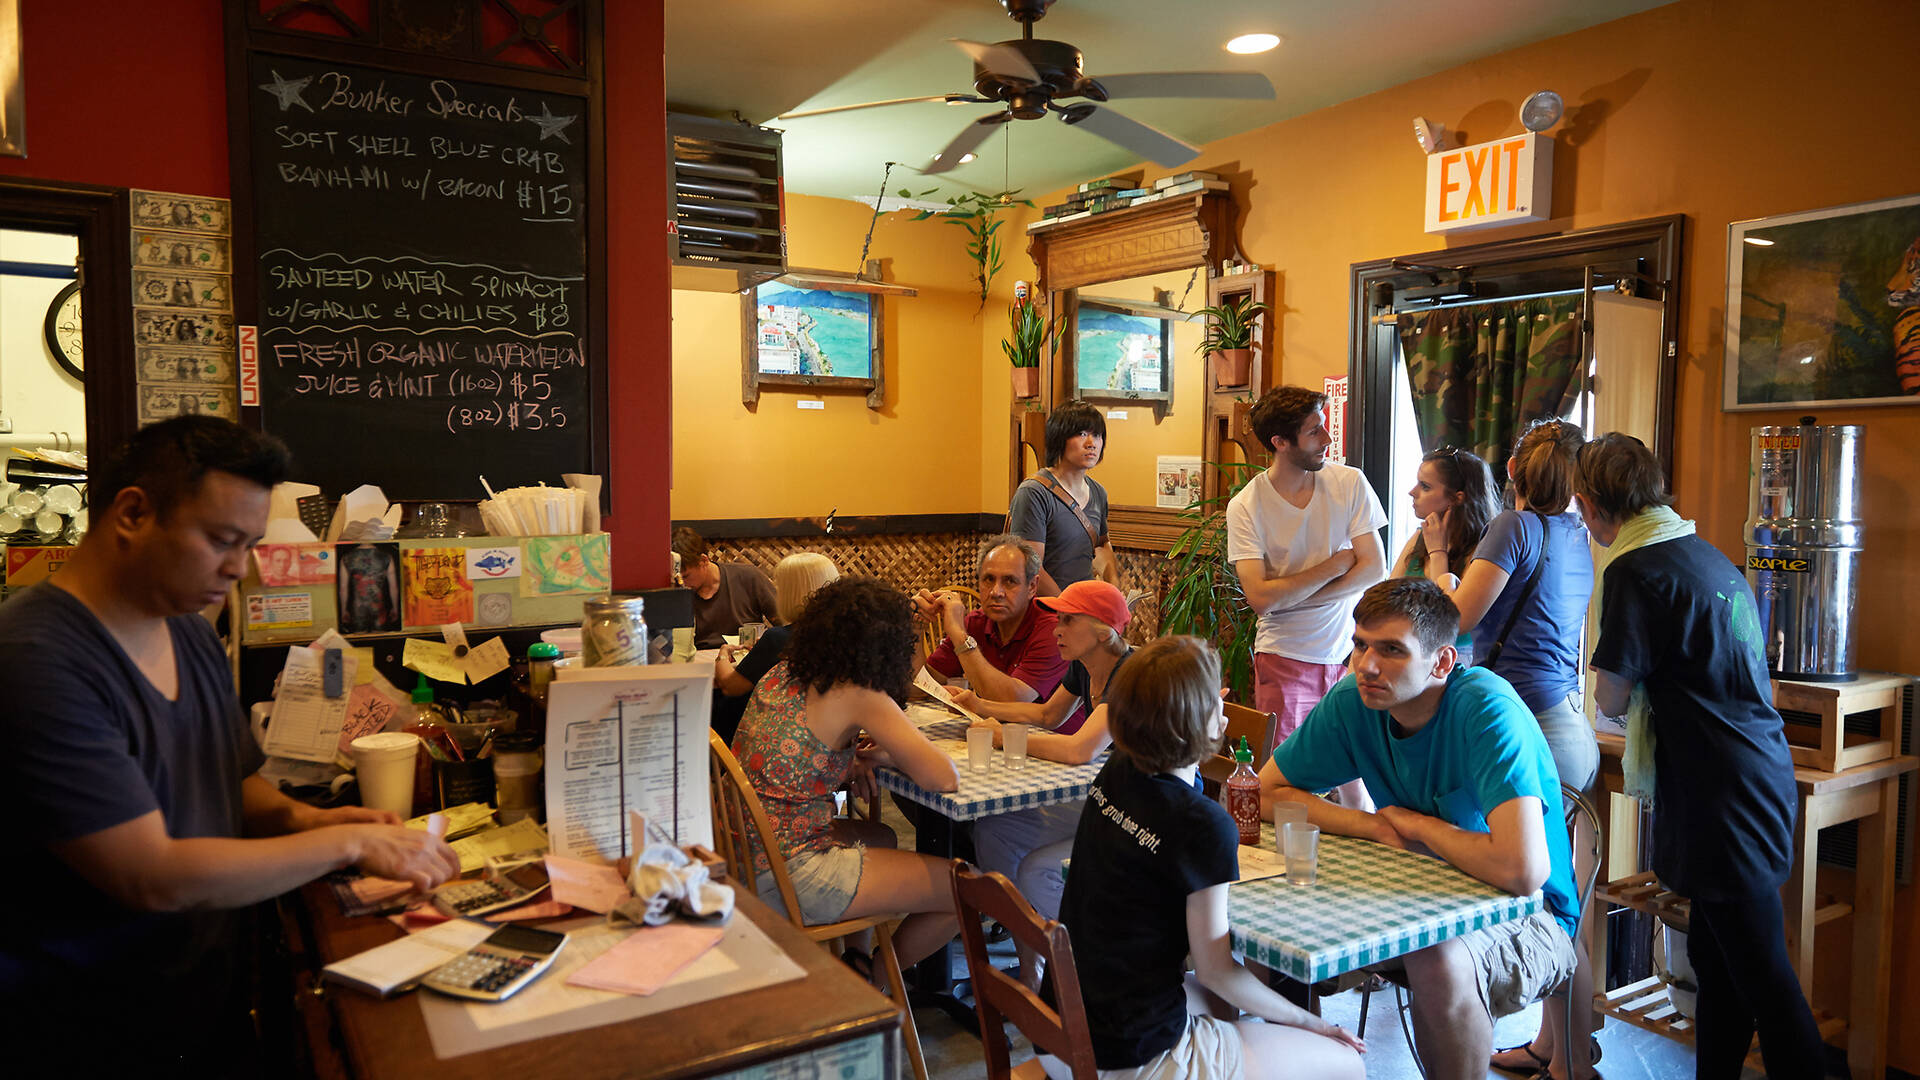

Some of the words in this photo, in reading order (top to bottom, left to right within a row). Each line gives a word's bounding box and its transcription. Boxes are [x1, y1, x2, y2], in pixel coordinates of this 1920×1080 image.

[319, 71, 413, 116] Bunker
[427, 79, 523, 122] Specials
[274, 125, 339, 154] SOFT
[347, 136, 417, 157] SHELL
[429, 136, 494, 160] BLUE
[501, 147, 565, 174] CRAB
[438, 178, 505, 200] BACON
[1438, 139, 1526, 223] EXIT
[270, 265, 373, 290] SAUTEED
[381, 269, 464, 296] WATER
[471, 275, 569, 303] SPINACH
[418, 302, 518, 325] CHILIES
[527, 302, 570, 331] $8
[241, 327, 257, 405] UNION
[273, 337, 361, 368] FRESH
[367, 341, 466, 367] ORGANIC
[474, 338, 586, 370] WATERMELON
[295, 374, 361, 396] JUICE
[510, 372, 552, 400] $5
[1326, 383, 1347, 397] FIRE
[507, 401, 567, 430] $3.5
[1759, 436, 1800, 449] UNITED
[616, 629, 631, 648] 5
[1102, 805, 1124, 824] grub
[1135, 827, 1160, 854] right.
